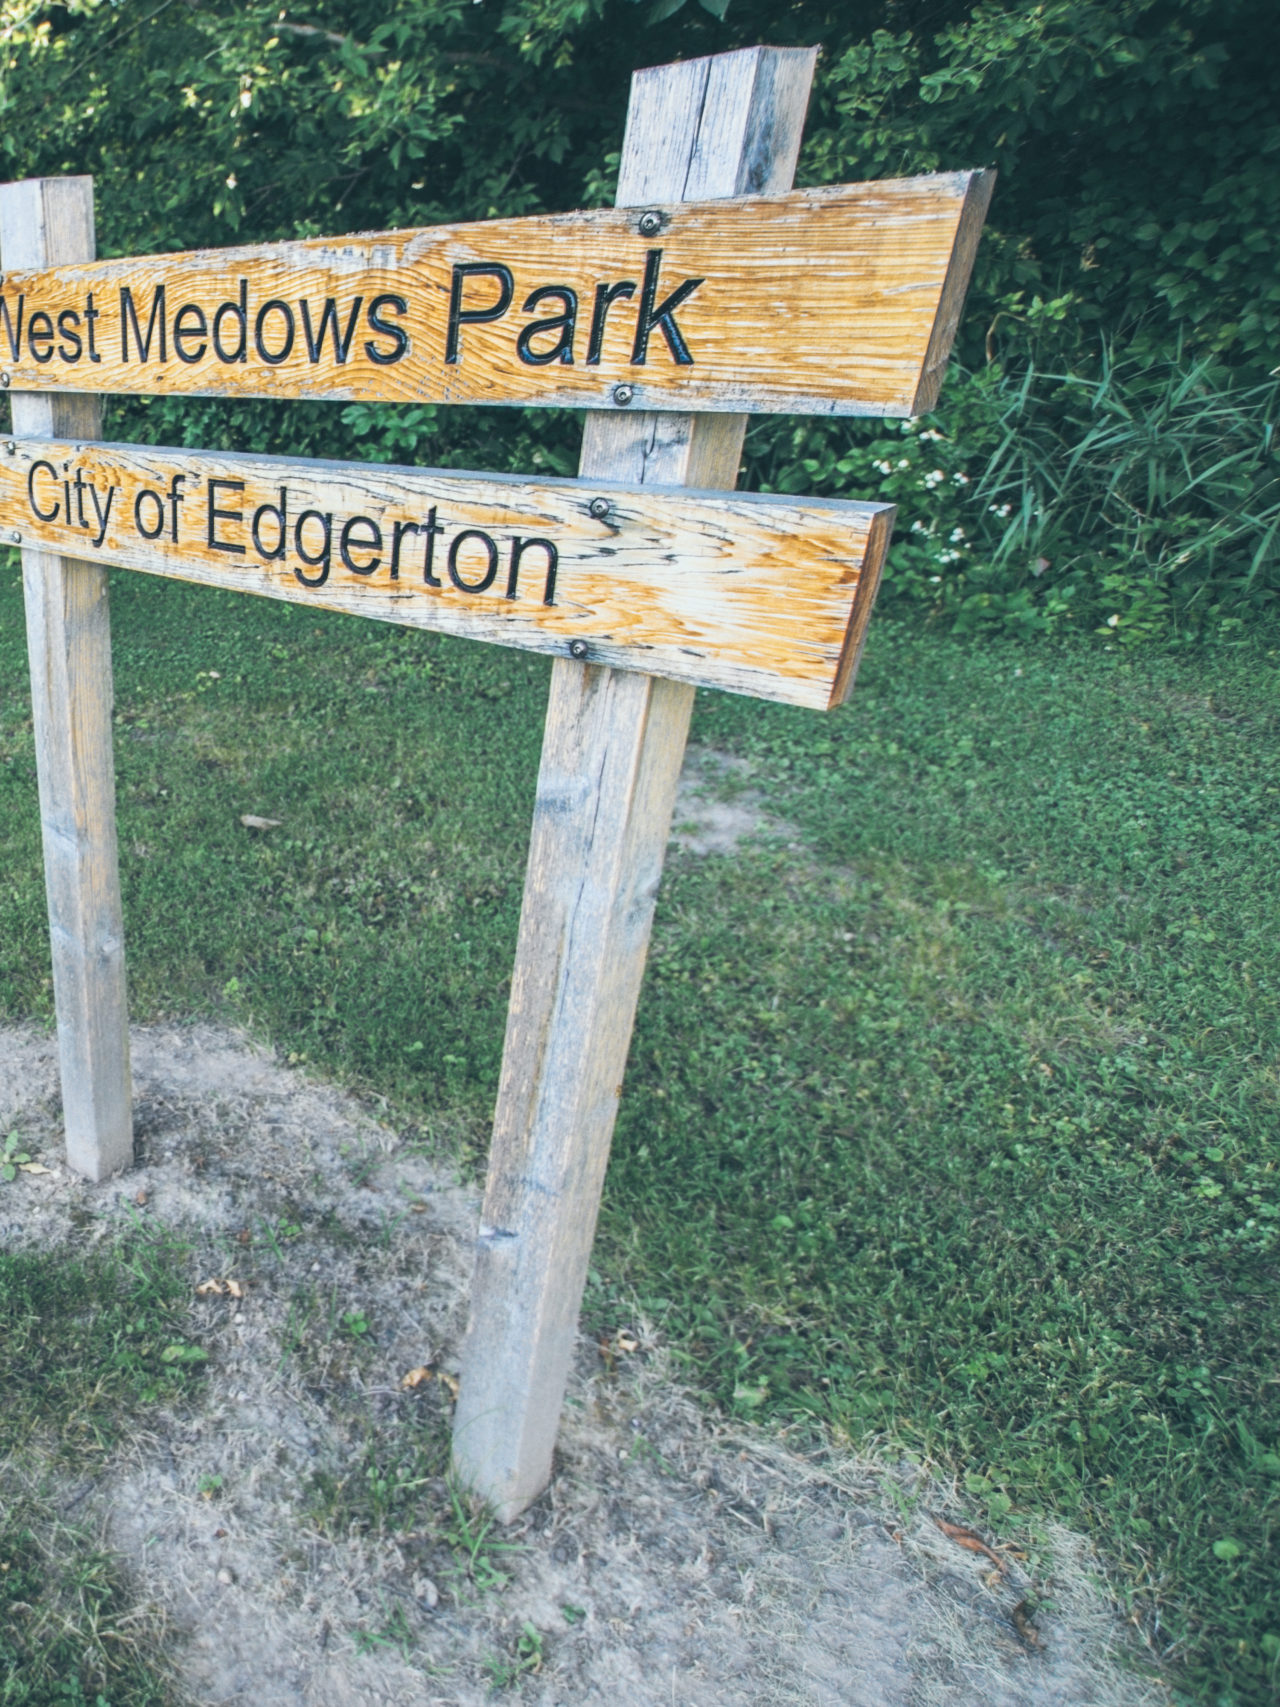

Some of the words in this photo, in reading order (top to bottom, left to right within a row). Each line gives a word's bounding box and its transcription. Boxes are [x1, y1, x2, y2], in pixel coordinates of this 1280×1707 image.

[119, 278, 411, 364] Medows
[444, 248, 706, 366] Park
[27, 459, 116, 548] City
[134, 474, 185, 544] of
[206, 477, 559, 606] Edgerton
